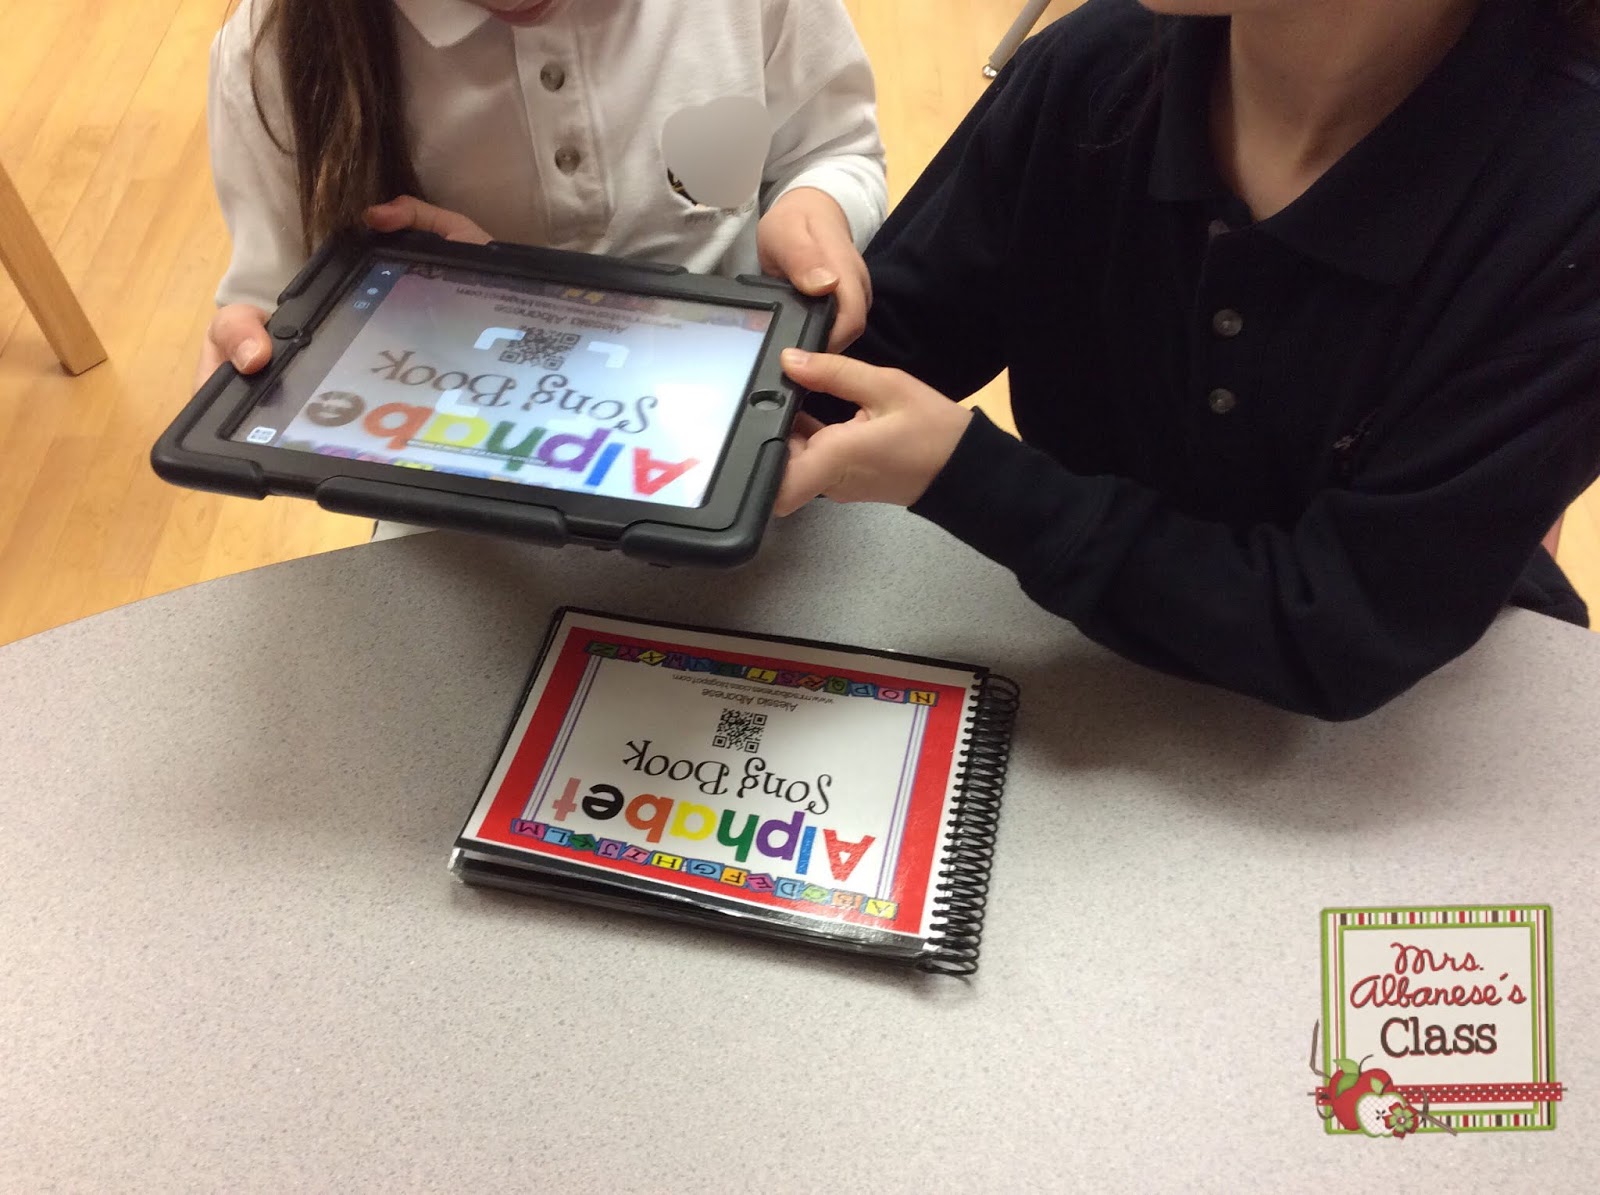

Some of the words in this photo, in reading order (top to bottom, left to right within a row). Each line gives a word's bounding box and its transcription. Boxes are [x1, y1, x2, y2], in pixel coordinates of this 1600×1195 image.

[370, 349, 519, 407] Book
[522, 373, 659, 434] Song
[305, 389, 701, 497] Alphabe
[701, 687, 755, 706] Albanese
[756, 696, 799, 712] Alessia
[622, 740, 730, 796] Book
[737, 756, 833, 815] Song
[551, 777, 877, 882] Alphabet
